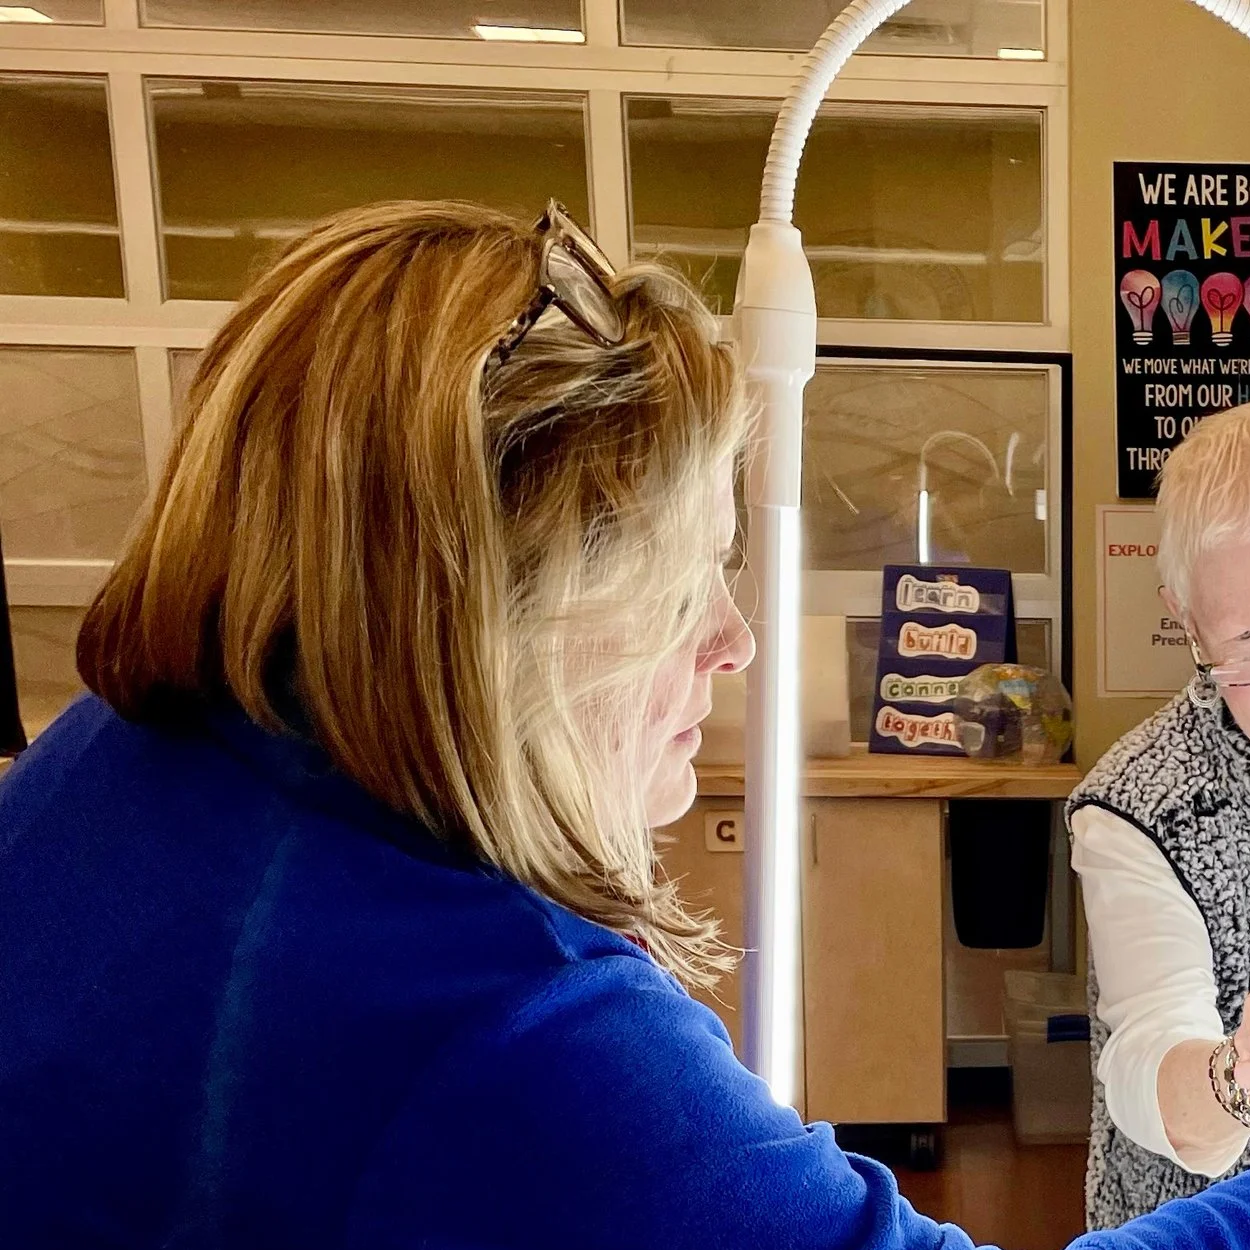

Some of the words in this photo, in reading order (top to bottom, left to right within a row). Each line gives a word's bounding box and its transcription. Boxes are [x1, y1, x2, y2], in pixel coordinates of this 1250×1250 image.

[1138, 173, 1176, 205] WE
[1183, 174, 1228, 206] ARE
[1122, 358, 1142, 374] WE
[1144, 358, 1178, 374] MOVE
[1180, 358, 1215, 375] WHAT
[1145, 384, 1193, 407] FROM
[1197, 384, 1233, 407] OUR
[1154, 416, 1176, 439] TO
[1126, 447, 1172, 471] THRO
[1108, 544, 1159, 557] EXPLO
[888, 682, 959, 698] conne
[883, 714, 953, 741] togeth
[717, 820, 736, 842] C
